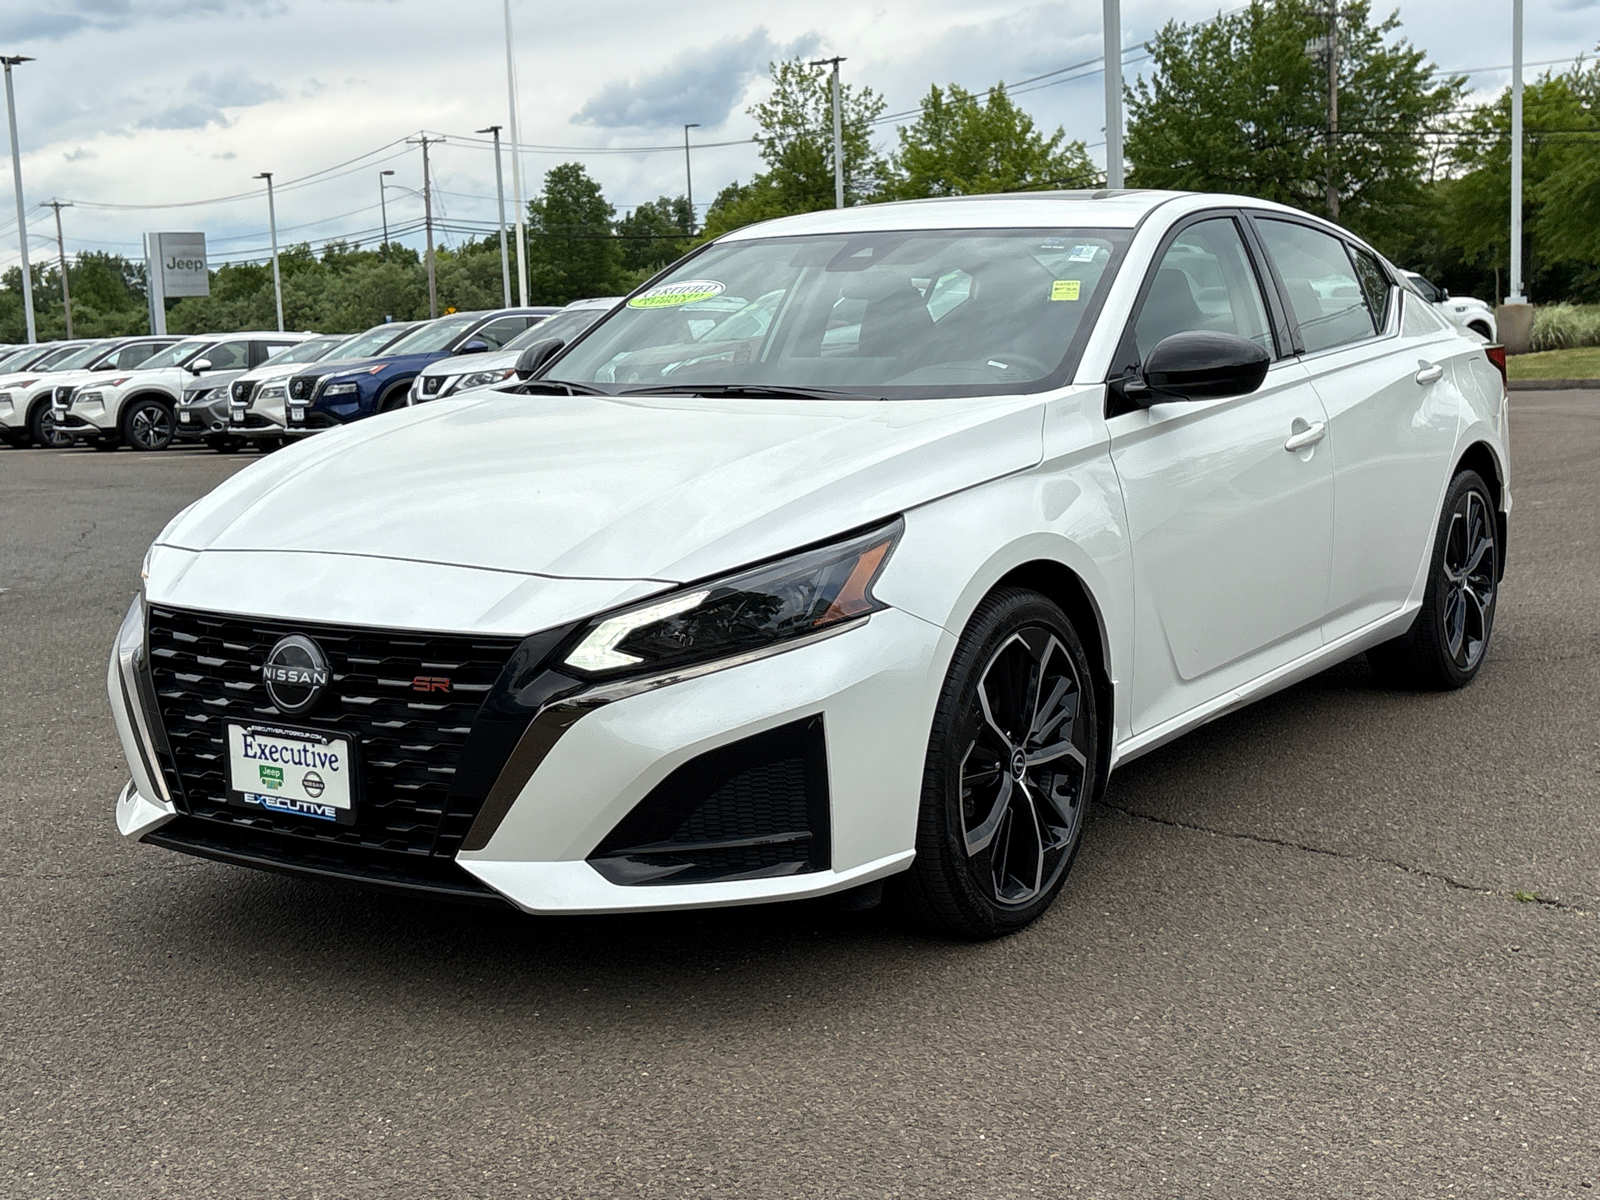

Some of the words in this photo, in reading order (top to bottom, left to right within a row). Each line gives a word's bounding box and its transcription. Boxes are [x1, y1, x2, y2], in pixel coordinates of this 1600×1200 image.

[166, 256, 203, 272] Jeep
[643, 285, 718, 298] CERTIFIED
[263, 666, 327, 684] NISSAN
[413, 676, 450, 693] SR
[242, 733, 339, 772] Executive
[262, 767, 281, 778] Jeep
[303, 780, 324, 788] NISSAN
[244, 792, 336, 817] EXECUTIVE
